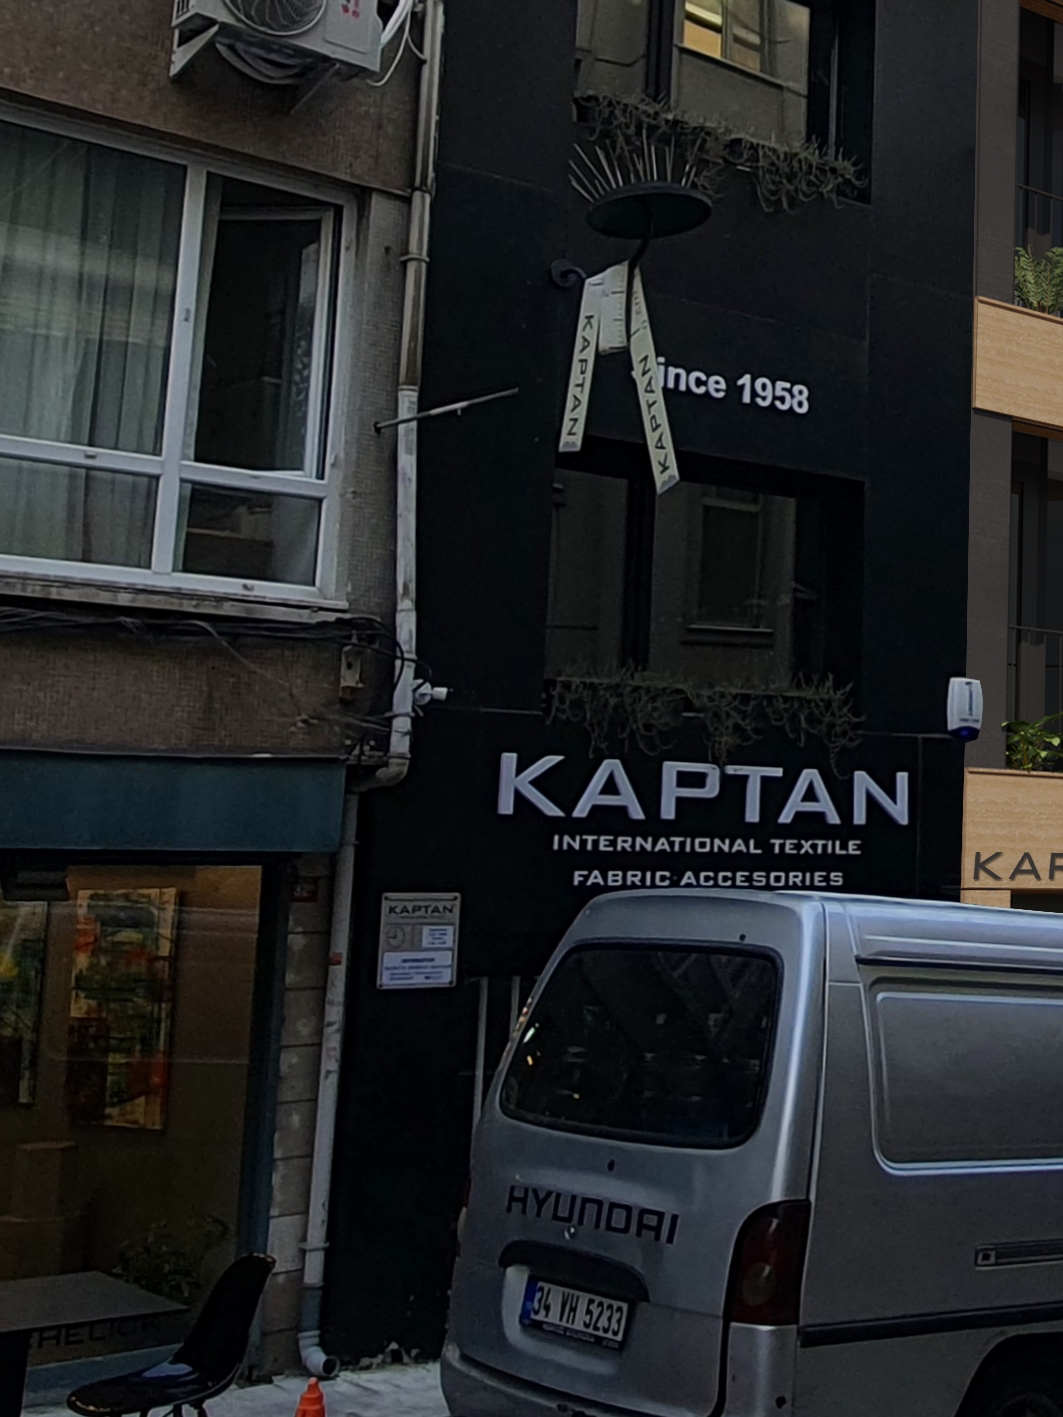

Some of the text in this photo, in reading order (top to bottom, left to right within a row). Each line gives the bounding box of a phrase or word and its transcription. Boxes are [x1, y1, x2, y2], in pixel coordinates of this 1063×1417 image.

[567, 315, 595, 436] KAPTAN
[631, 356, 810, 415] ince 1958
[638, 354, 670, 475] KAPTAN
[496, 751, 910, 827] KAPTAN
[553, 834, 863, 856] INTERNATIONAL TEXTILE
[572, 869, 844, 888] FABRIC ACCESORIES
[388, 903, 455, 915] KAPTAN
[505, 1184, 680, 1245] HYUNDAI
[532, 1285, 552, 1319] 34
[558, 1293, 580, 1325] VH
[582, 1298, 624, 1337] 5233
